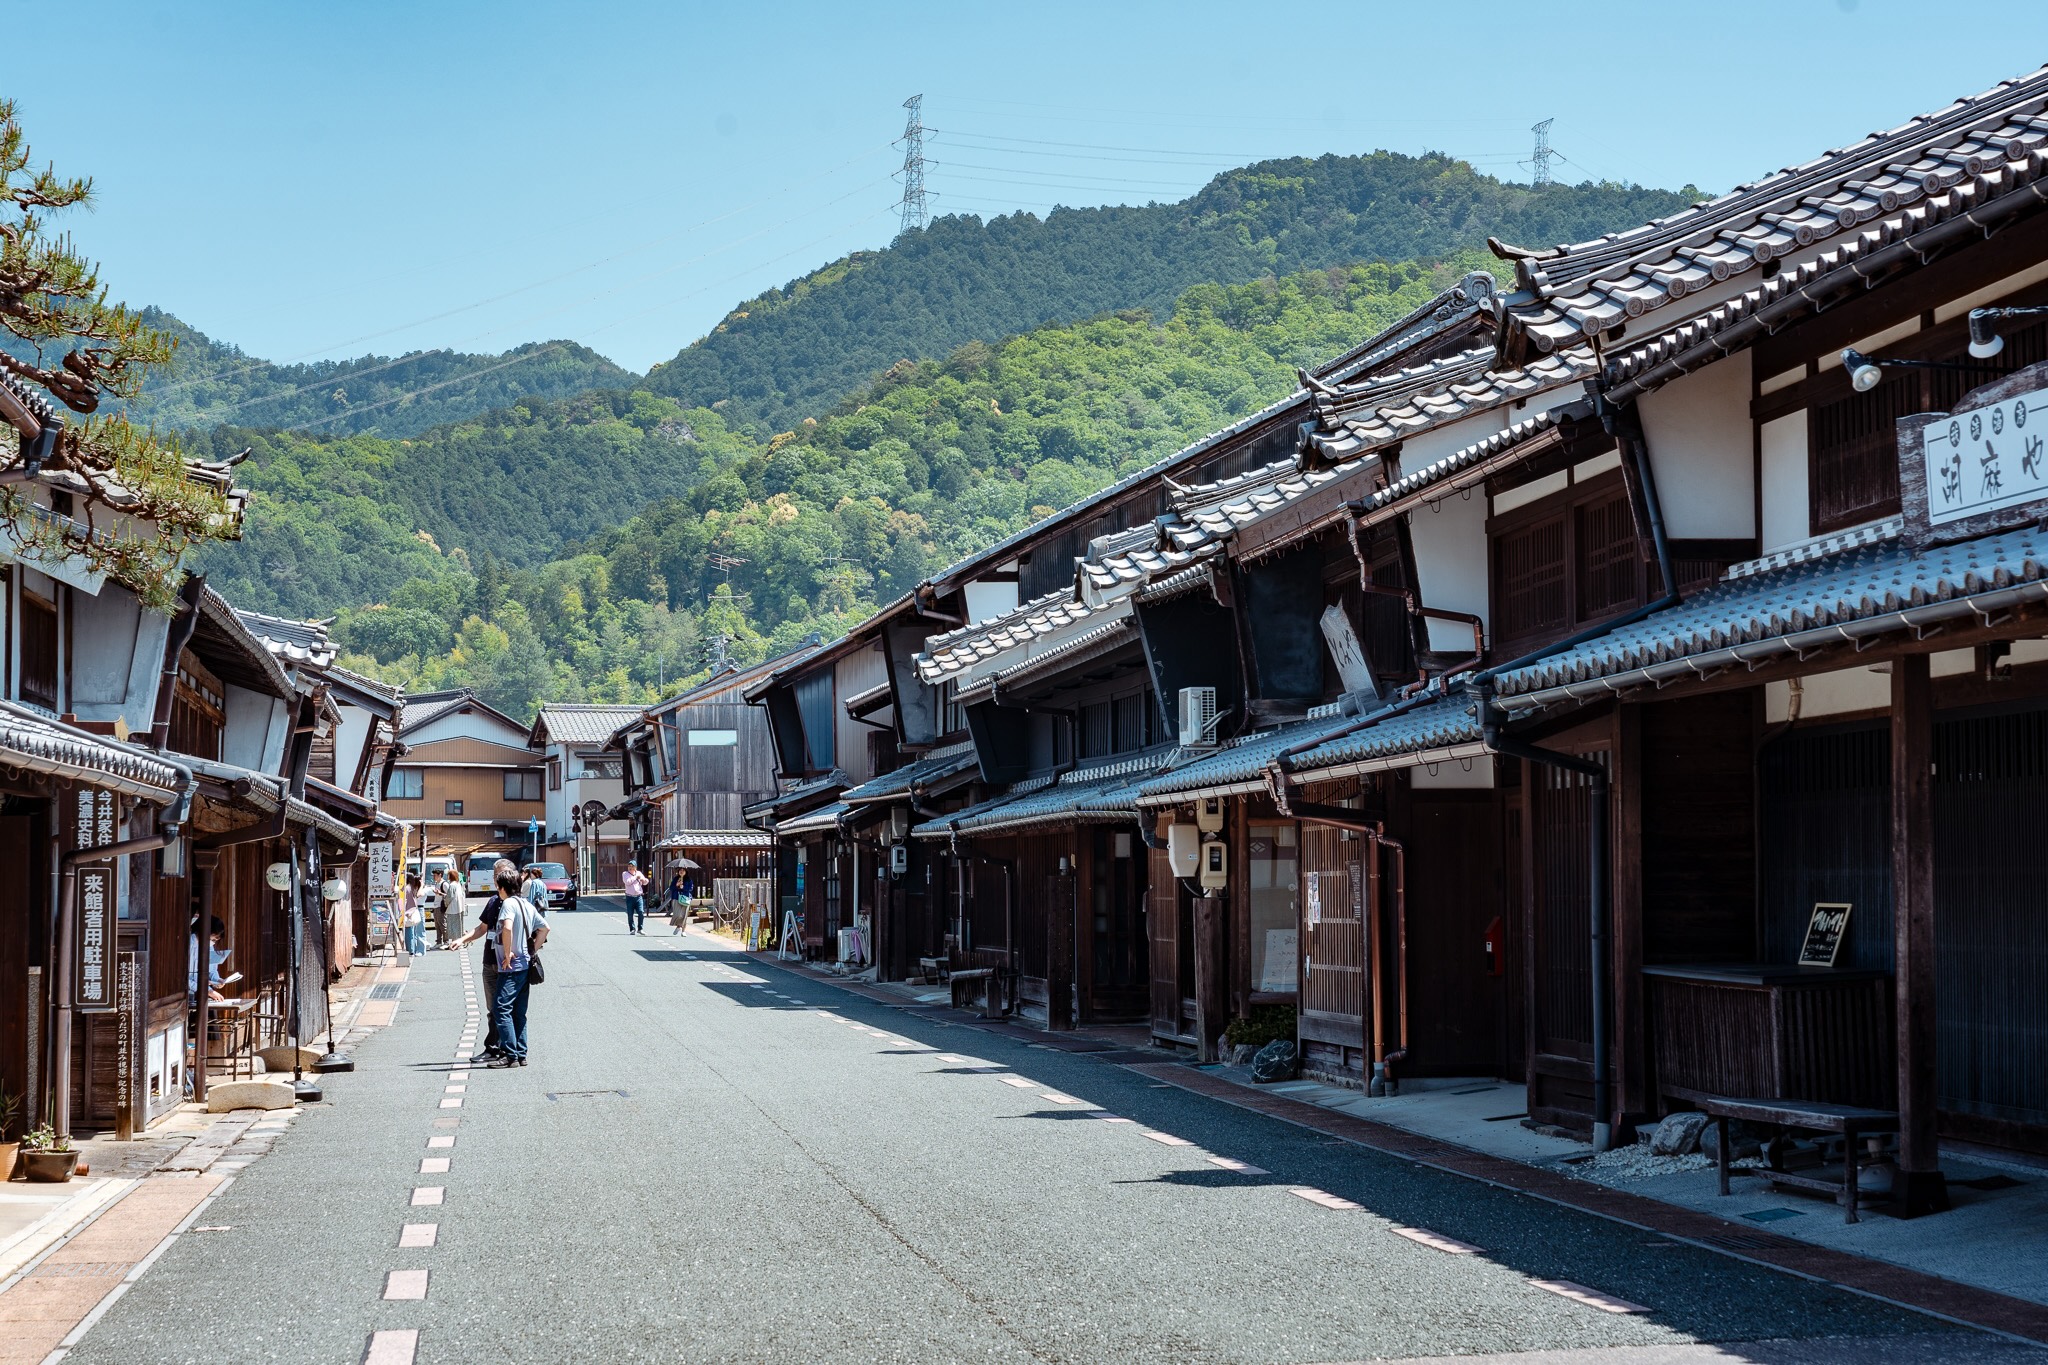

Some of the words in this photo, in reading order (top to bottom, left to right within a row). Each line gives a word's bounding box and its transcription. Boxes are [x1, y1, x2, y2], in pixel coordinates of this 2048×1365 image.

[97, 789, 113, 862] 今井家住
[371, 847, 381, 883] 五平もち
[83, 873, 104, 1000] 来館者用駐車場
